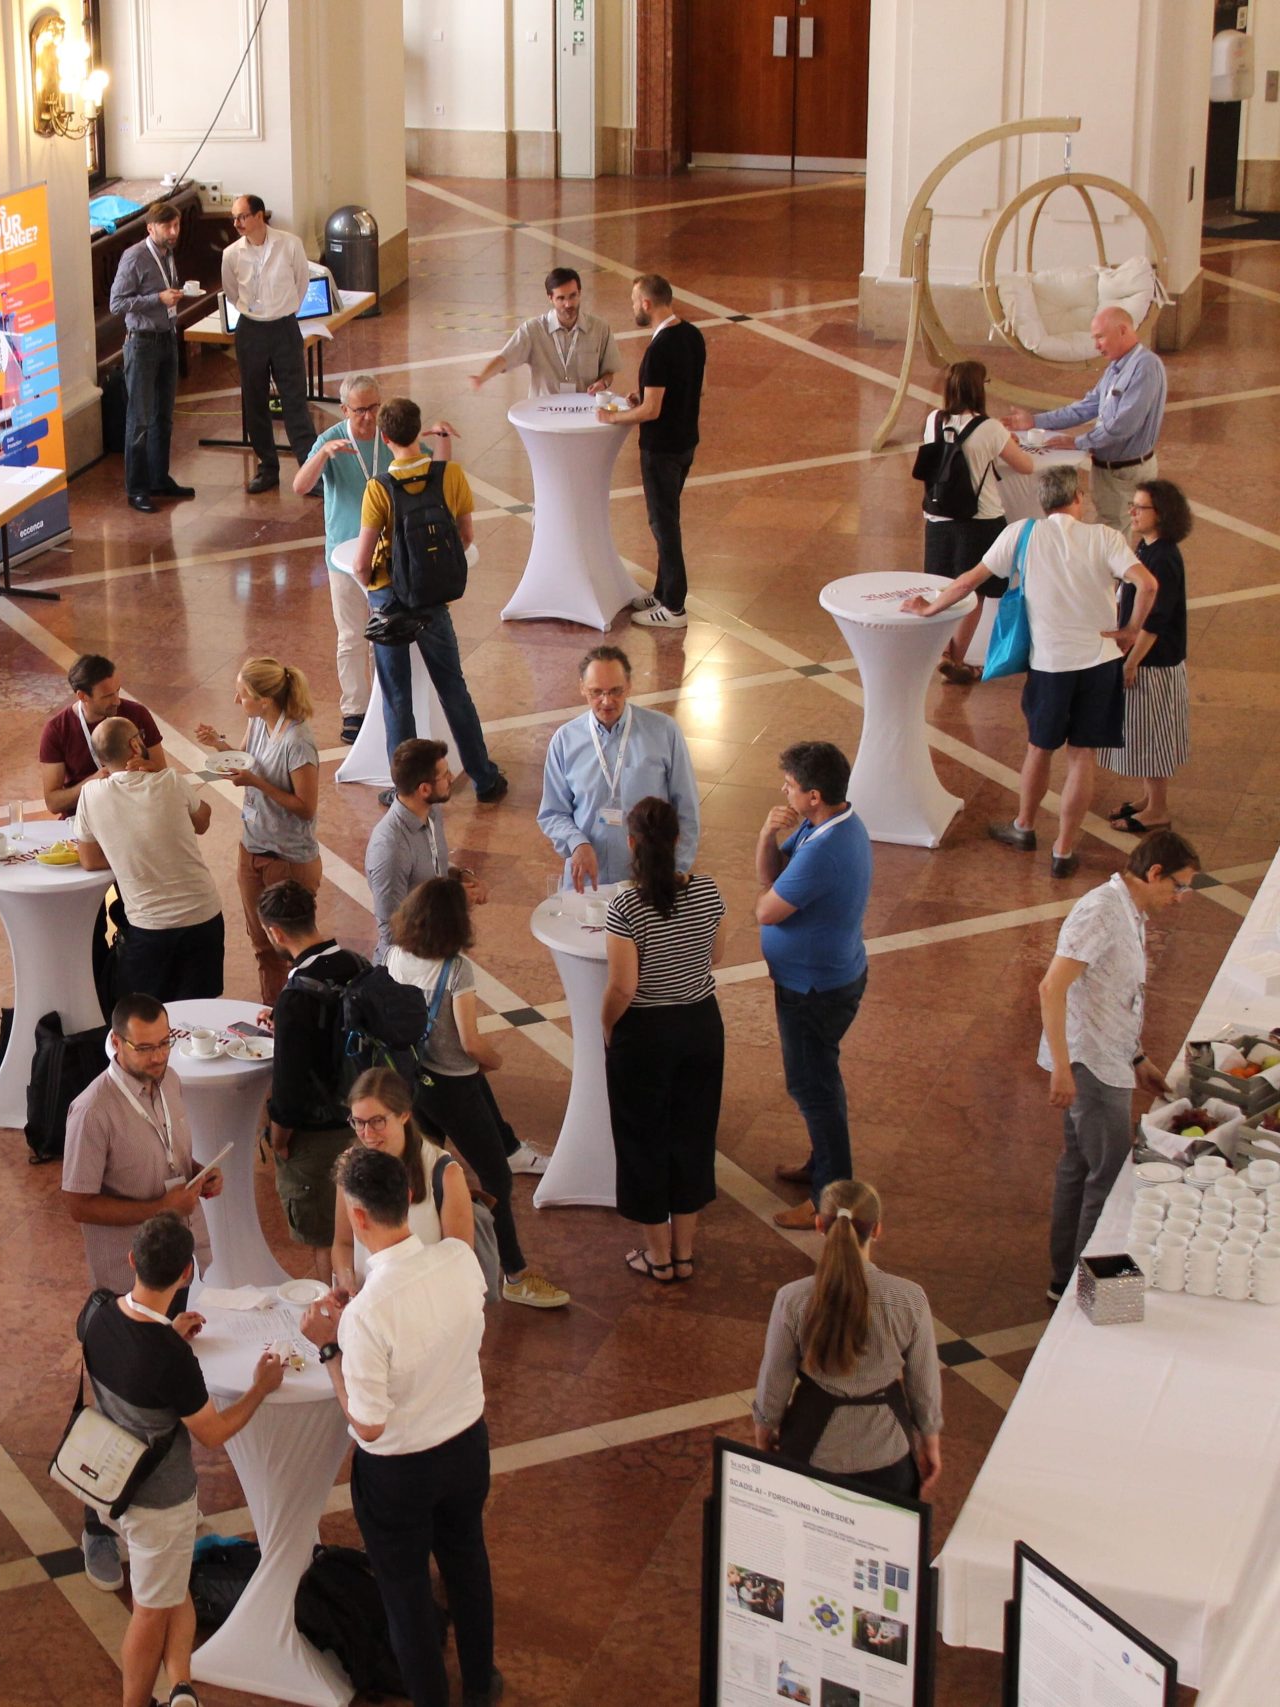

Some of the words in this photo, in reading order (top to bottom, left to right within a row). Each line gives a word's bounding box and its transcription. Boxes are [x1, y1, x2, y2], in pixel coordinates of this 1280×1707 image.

[20, 520, 44, 538] eccenca
[768, 1491, 811, 1512] FORSCHUNG
[812, 1506, 820, 1515] IN
[821, 1509, 856, 1526] DRESDEN
